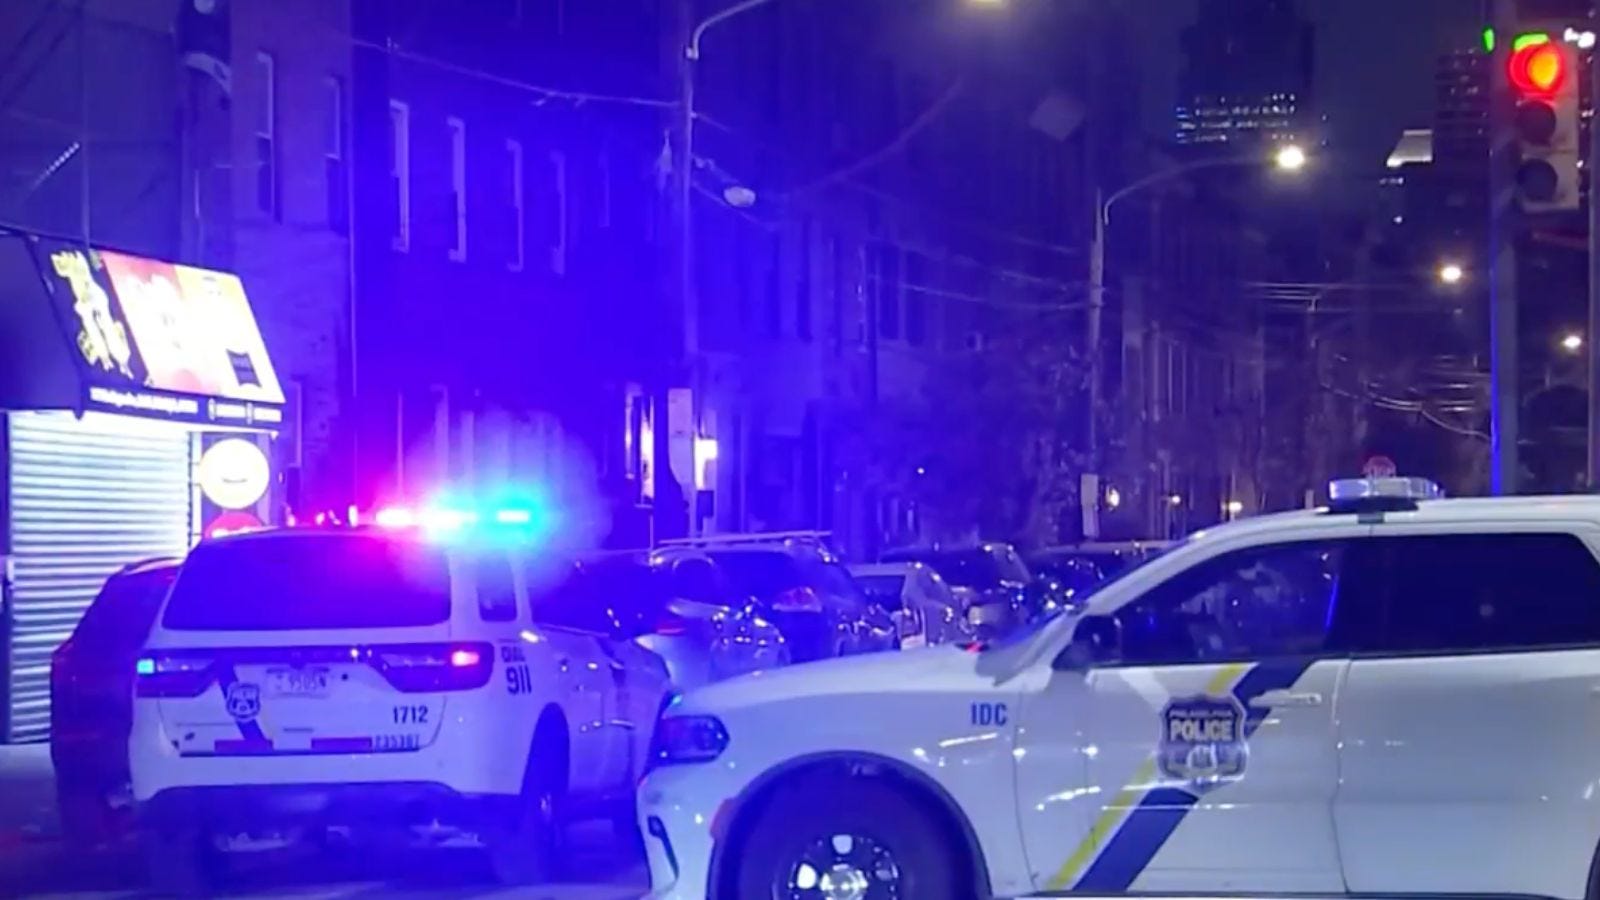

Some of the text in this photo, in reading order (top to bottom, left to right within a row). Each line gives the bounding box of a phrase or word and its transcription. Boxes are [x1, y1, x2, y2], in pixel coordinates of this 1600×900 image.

[506, 665, 531, 694] 911
[393, 705, 428, 724] 1712
[1170, 719, 1232, 742] POLICE
